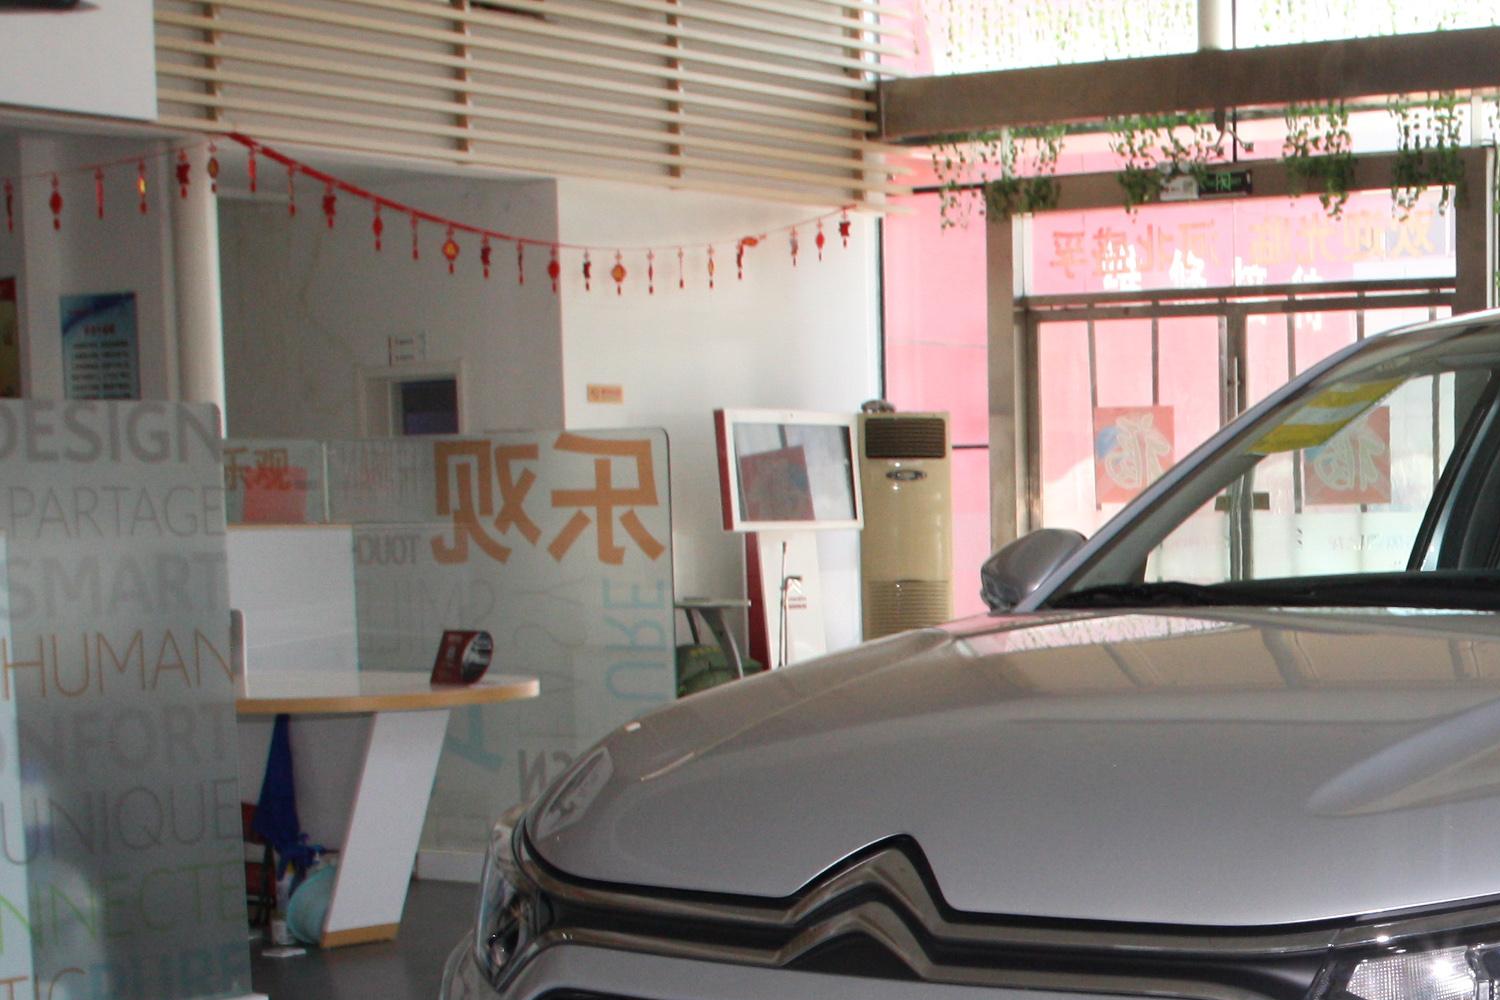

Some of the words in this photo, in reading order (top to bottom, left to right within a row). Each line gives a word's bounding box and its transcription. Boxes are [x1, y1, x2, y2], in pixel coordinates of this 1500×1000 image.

[8, 485, 226, 540] PARTAGE
[1, 628, 236, 701] HUMAN
[0, 702, 236, 777] NFORT
[2, 777, 242, 866] UNIQUE
